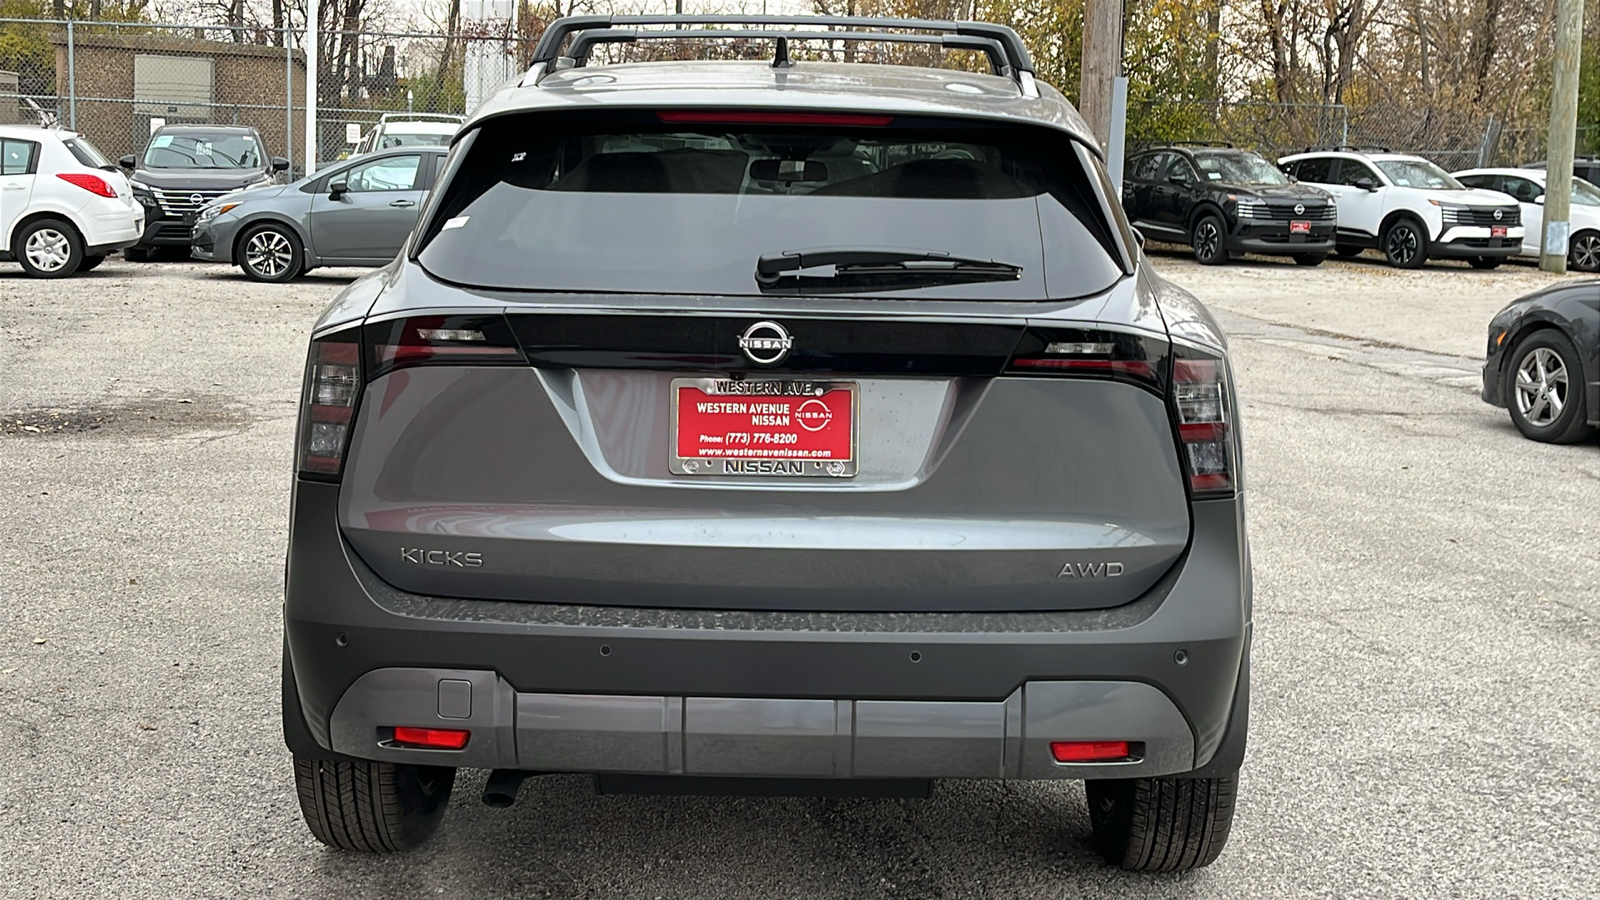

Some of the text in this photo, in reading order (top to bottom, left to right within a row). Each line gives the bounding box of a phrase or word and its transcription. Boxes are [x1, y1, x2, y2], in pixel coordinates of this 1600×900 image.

[739, 339, 792, 349] NISSAN
[715, 381, 815, 396] WESTERN AVE.
[697, 402, 790, 414] WESTERN AVENUE
[752, 415, 790, 426] NISSAN
[795, 411, 833, 419] NISSAN
[699, 432, 798, 446] Phone: (773) 776-8200
[699, 448, 832, 458] www.westernavenissan.com
[723, 460, 805, 474] NISSAN
[400, 547, 484, 567] KICKS
[1056, 562, 1125, 578] AWD
